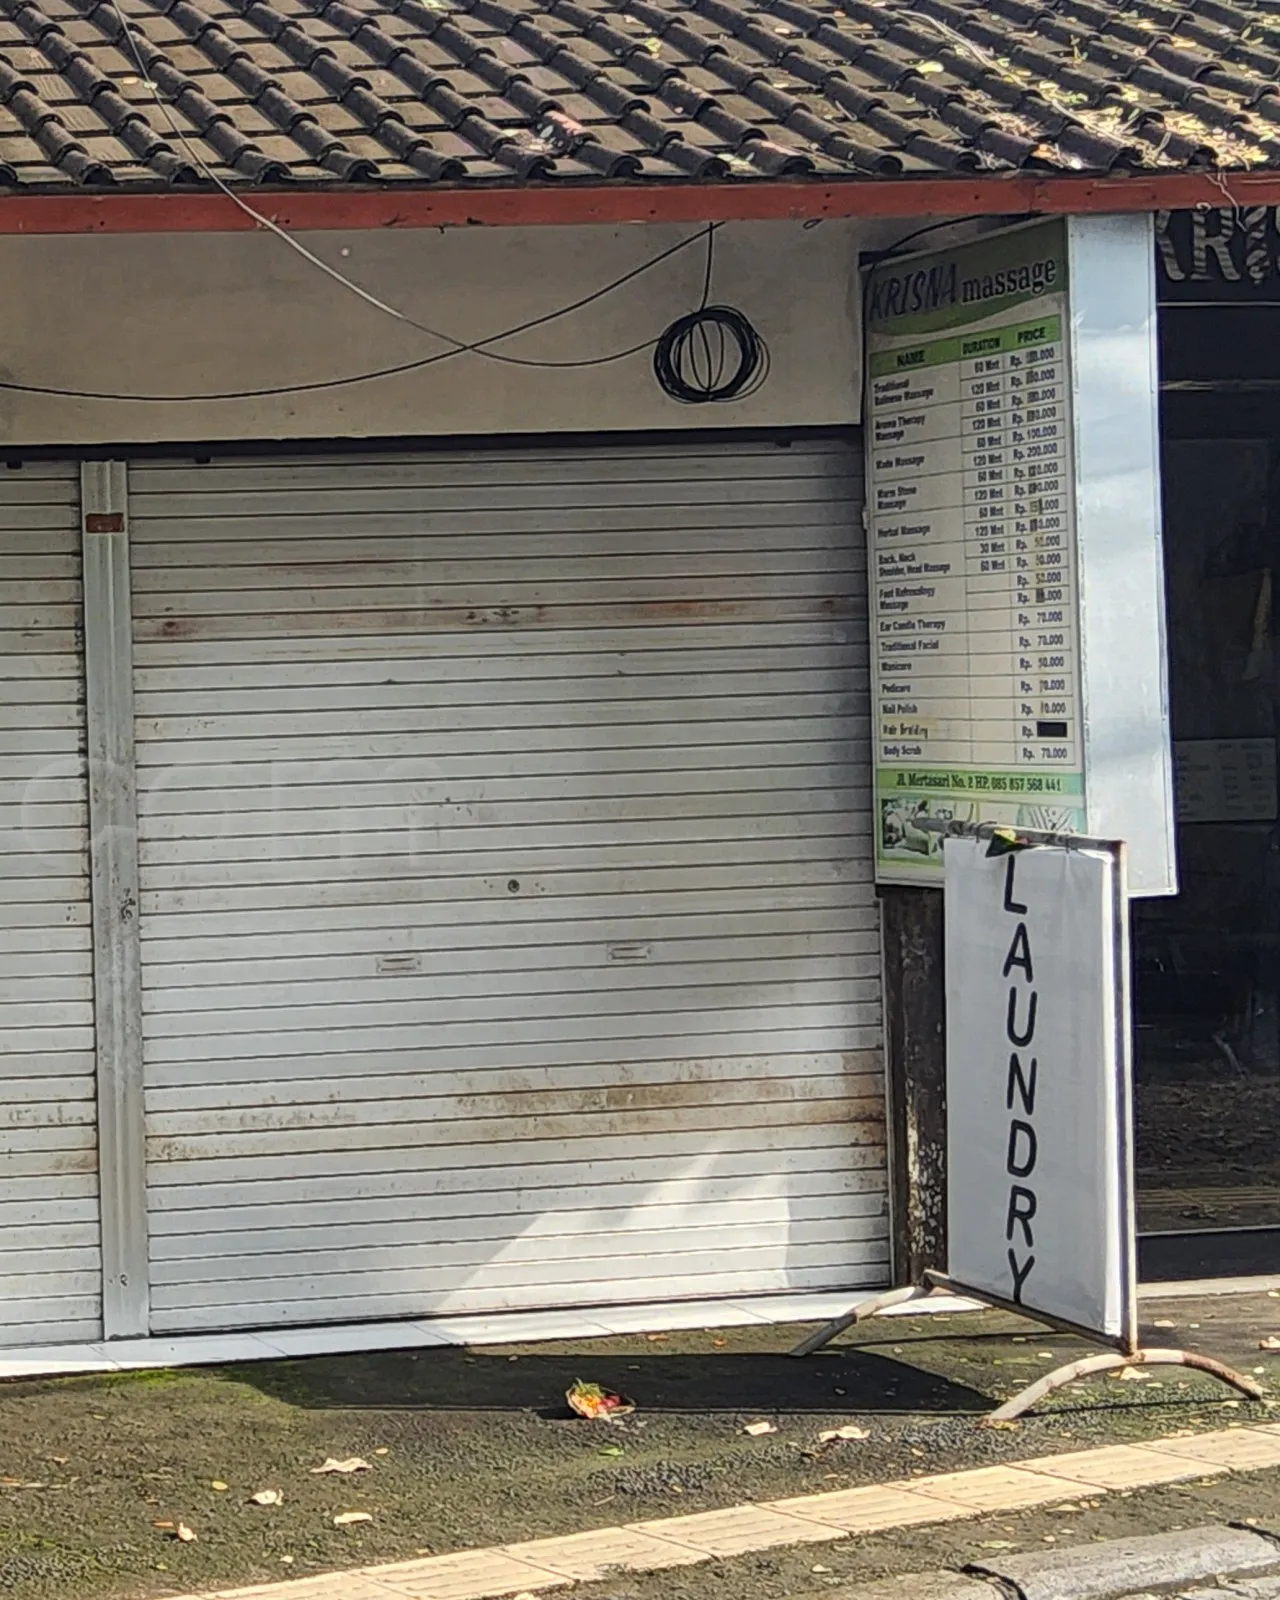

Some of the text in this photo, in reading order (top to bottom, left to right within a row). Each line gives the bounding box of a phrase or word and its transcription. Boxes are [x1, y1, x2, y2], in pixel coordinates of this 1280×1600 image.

[872, 258, 1056, 321] KRISNA massage
[897, 326, 1046, 367] NAME DURATION PRICE
[986, 360, 999, 370] Mnt
[986, 381, 1000, 392] Mnt
[987, 399, 1000, 409] Mnt
[898, 415, 925, 426] Therapy
[987, 417, 1001, 428] Mnt
[988, 435, 1001, 446] Mnt
[895, 456, 924, 467] Massage
[988, 453, 1002, 464] Mnt
[989, 469, 1002, 480] Mnt
[990, 488, 1003, 499] Mnt
[990, 506, 1004, 516] Mnt
[901, 525, 930, 536] Massage
[991, 525, 1004, 535] Mnt
[991, 542, 1005, 552] Mnt
[924, 563, 950, 574] Massage
[991, 560, 1005, 570] Mnt
[917, 619, 945, 630] Therapy
[1019, 614, 1030, 626] Rp.
[918, 639, 939, 650] Facial
[1019, 636, 1031, 649] Rp.
[1038, 634, 1063, 646] 70.000
[1020, 658, 1032, 670] Rp.
[1021, 681, 1032, 693] Rp.
[882, 704, 895, 714] Nail
[897, 704, 917, 714] Polish
[1022, 704, 1033, 715] Rp.
[1022, 726, 1034, 738] Rp.
[884, 745, 1067, 761] Body Scrub Rp. 70.000
[908, 773, 949, 787] Mertasari
[952, 775, 965, 788] No.
[975, 776, 989, 789] HP.
[992, 778, 1007, 790] 085
[1009, 778, 1024, 790] 857
[1027, 778, 1043, 791] 568
[1045, 779, 1061, 791] 441
[1003, 855, 1037, 1303] LAUNDRY
